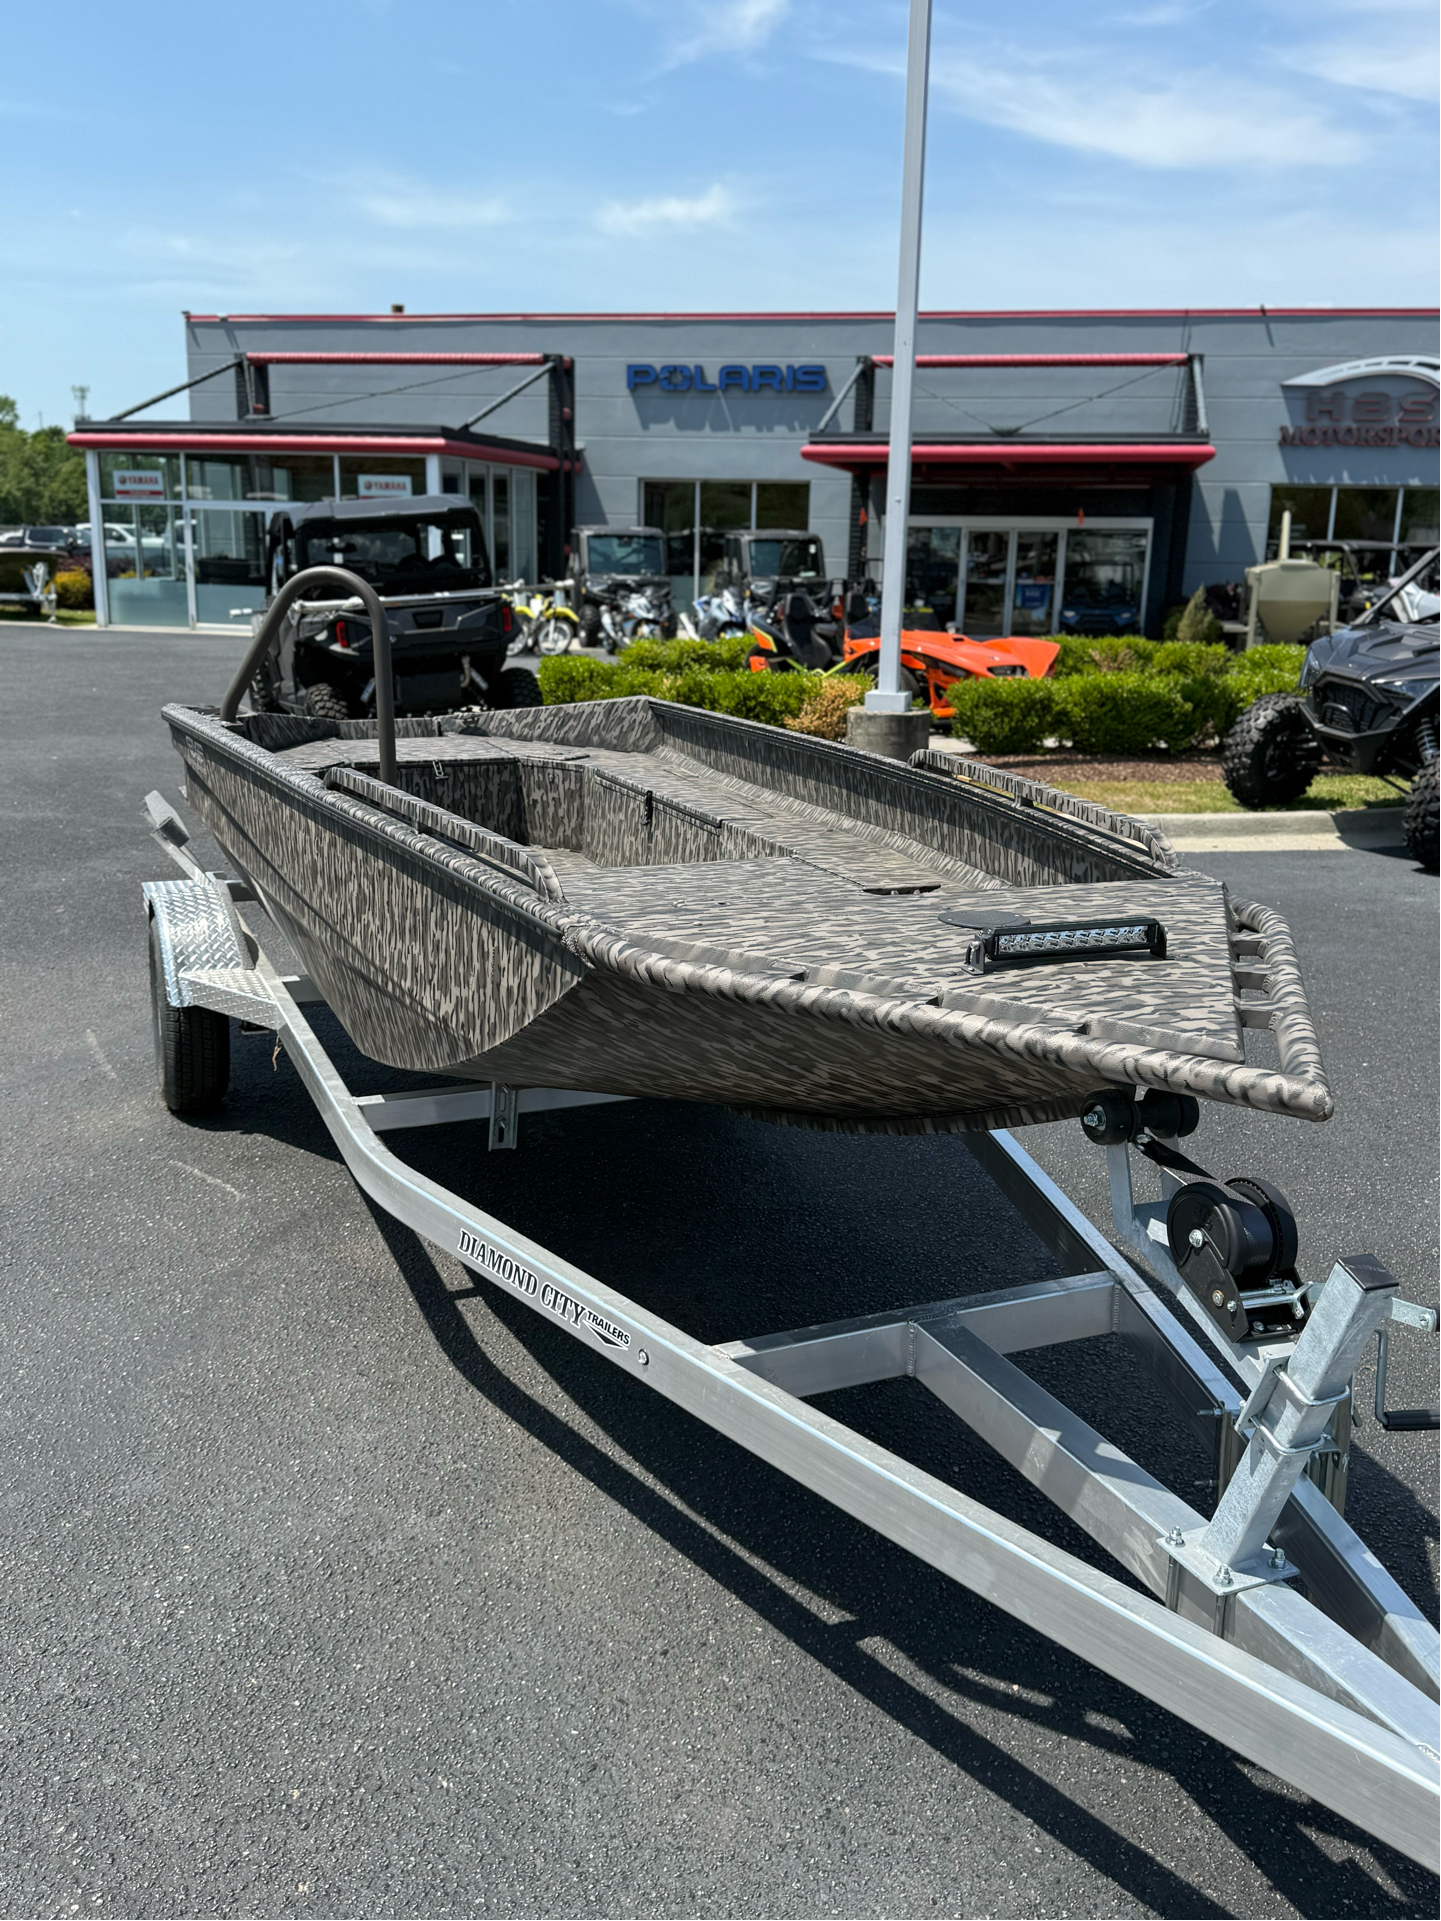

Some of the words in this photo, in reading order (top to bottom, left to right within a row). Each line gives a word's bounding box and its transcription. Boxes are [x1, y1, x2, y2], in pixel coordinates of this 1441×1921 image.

[626, 364, 827, 391] POLARIS
[127, 475, 159, 485] YAMAHA
[374, 481, 407, 491] YAMAHA
[458, 1229, 538, 1297] DIAMOND
[541, 1281, 587, 1329] CITY
[586, 1310, 631, 1346] TRAILERS
